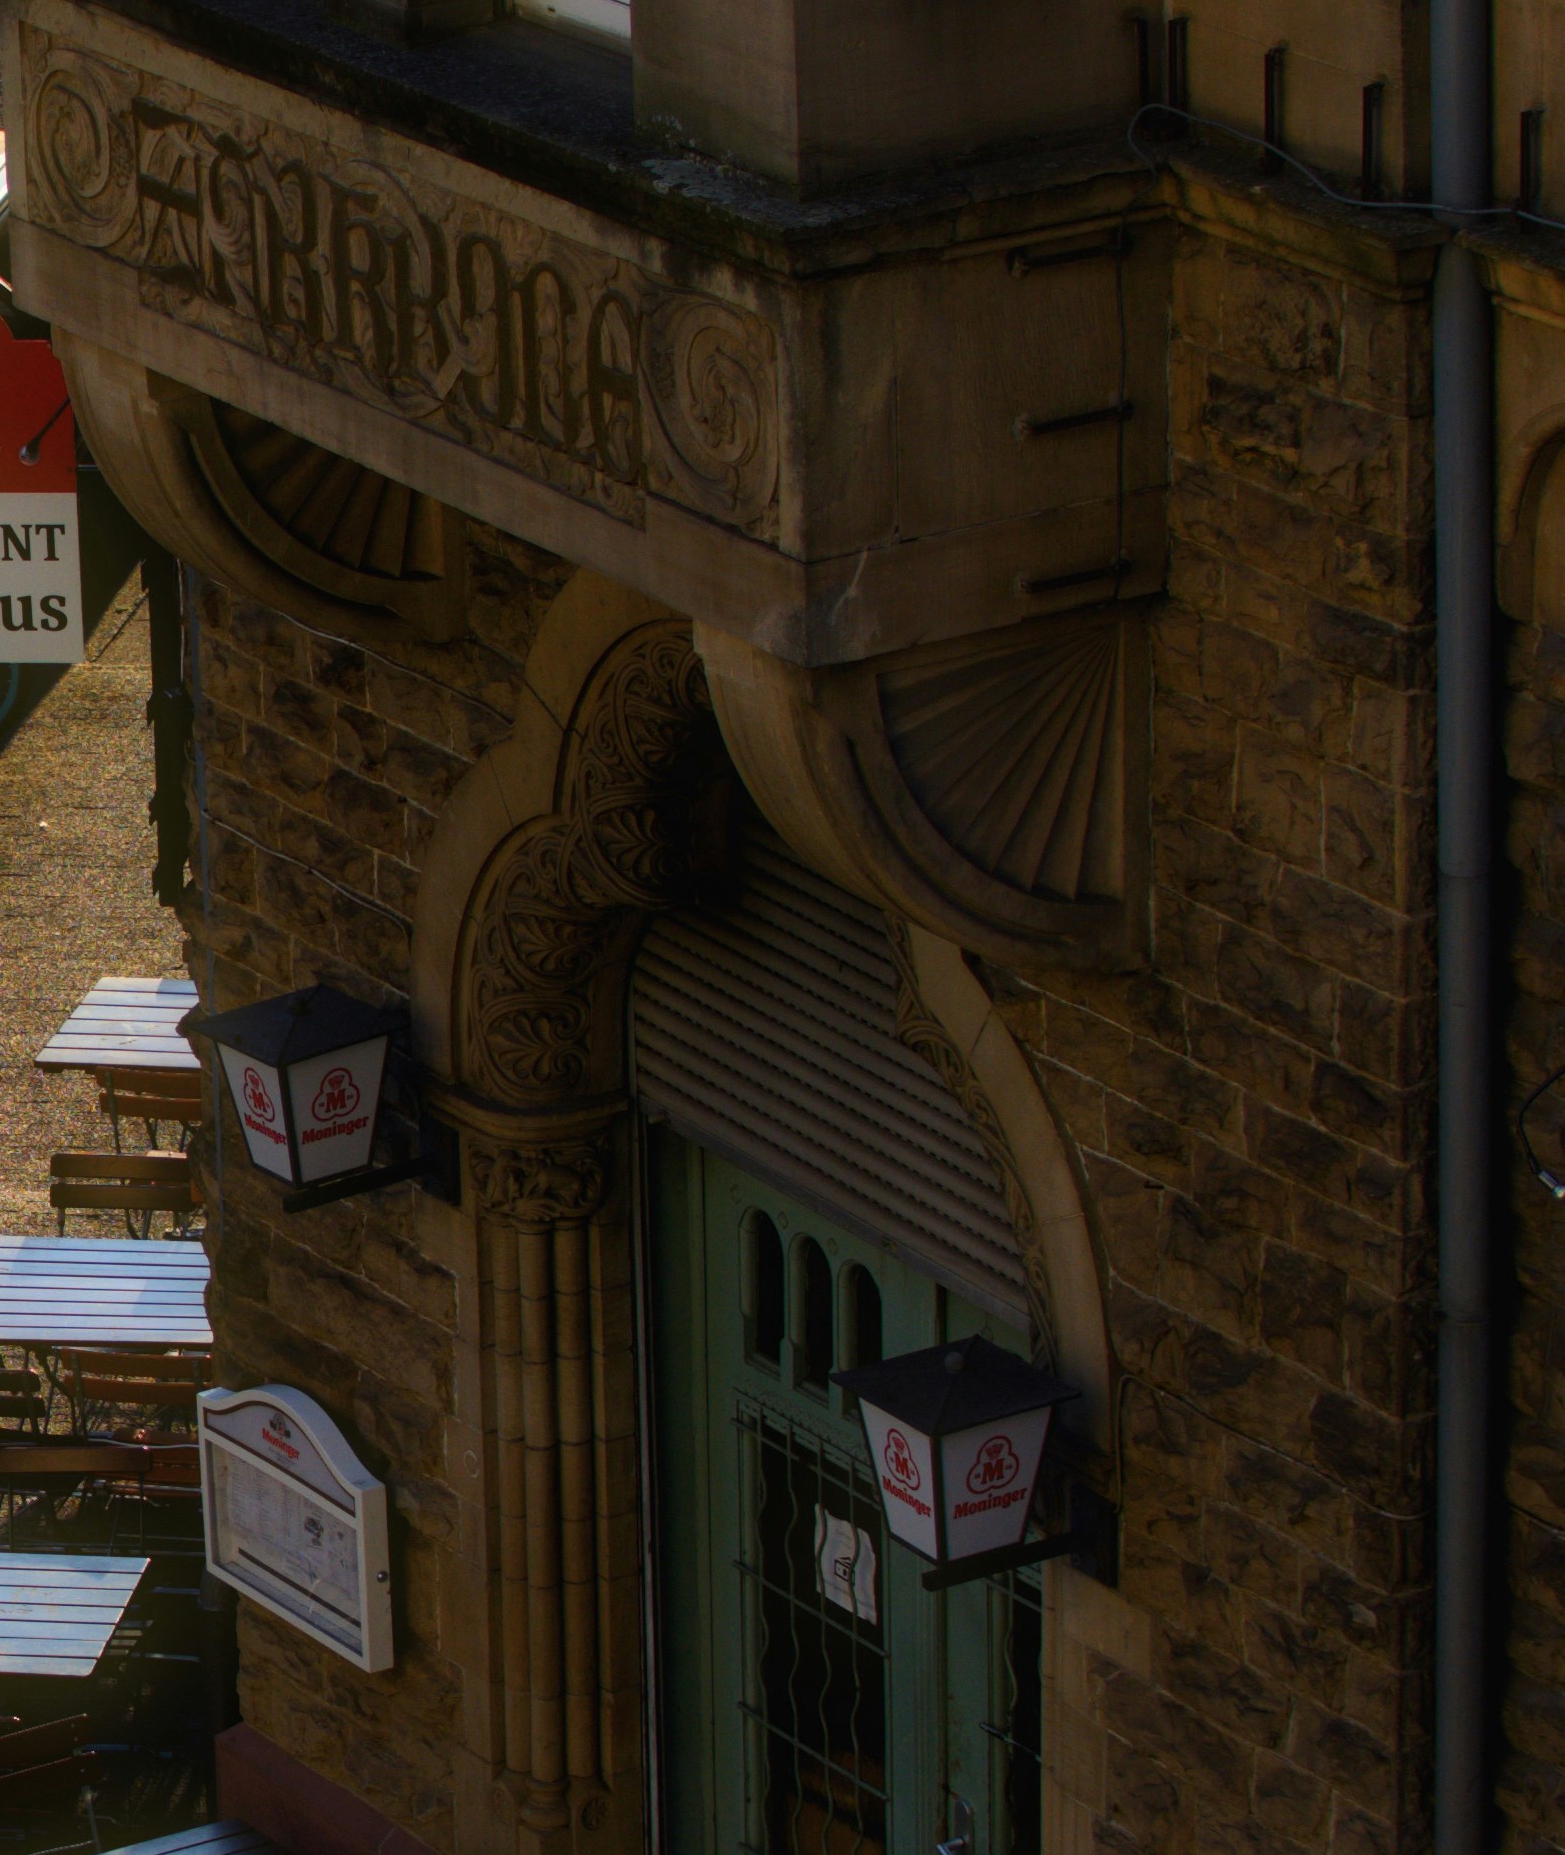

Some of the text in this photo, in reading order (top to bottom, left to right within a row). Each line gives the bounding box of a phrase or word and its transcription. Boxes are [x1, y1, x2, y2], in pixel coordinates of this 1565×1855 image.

[244, 1113, 286, 1145] Moninger
[302, 1116, 369, 1144] Moninger
[882, 1476, 931, 1517] Moninger
[954, 1488, 1027, 1519] Moninger
